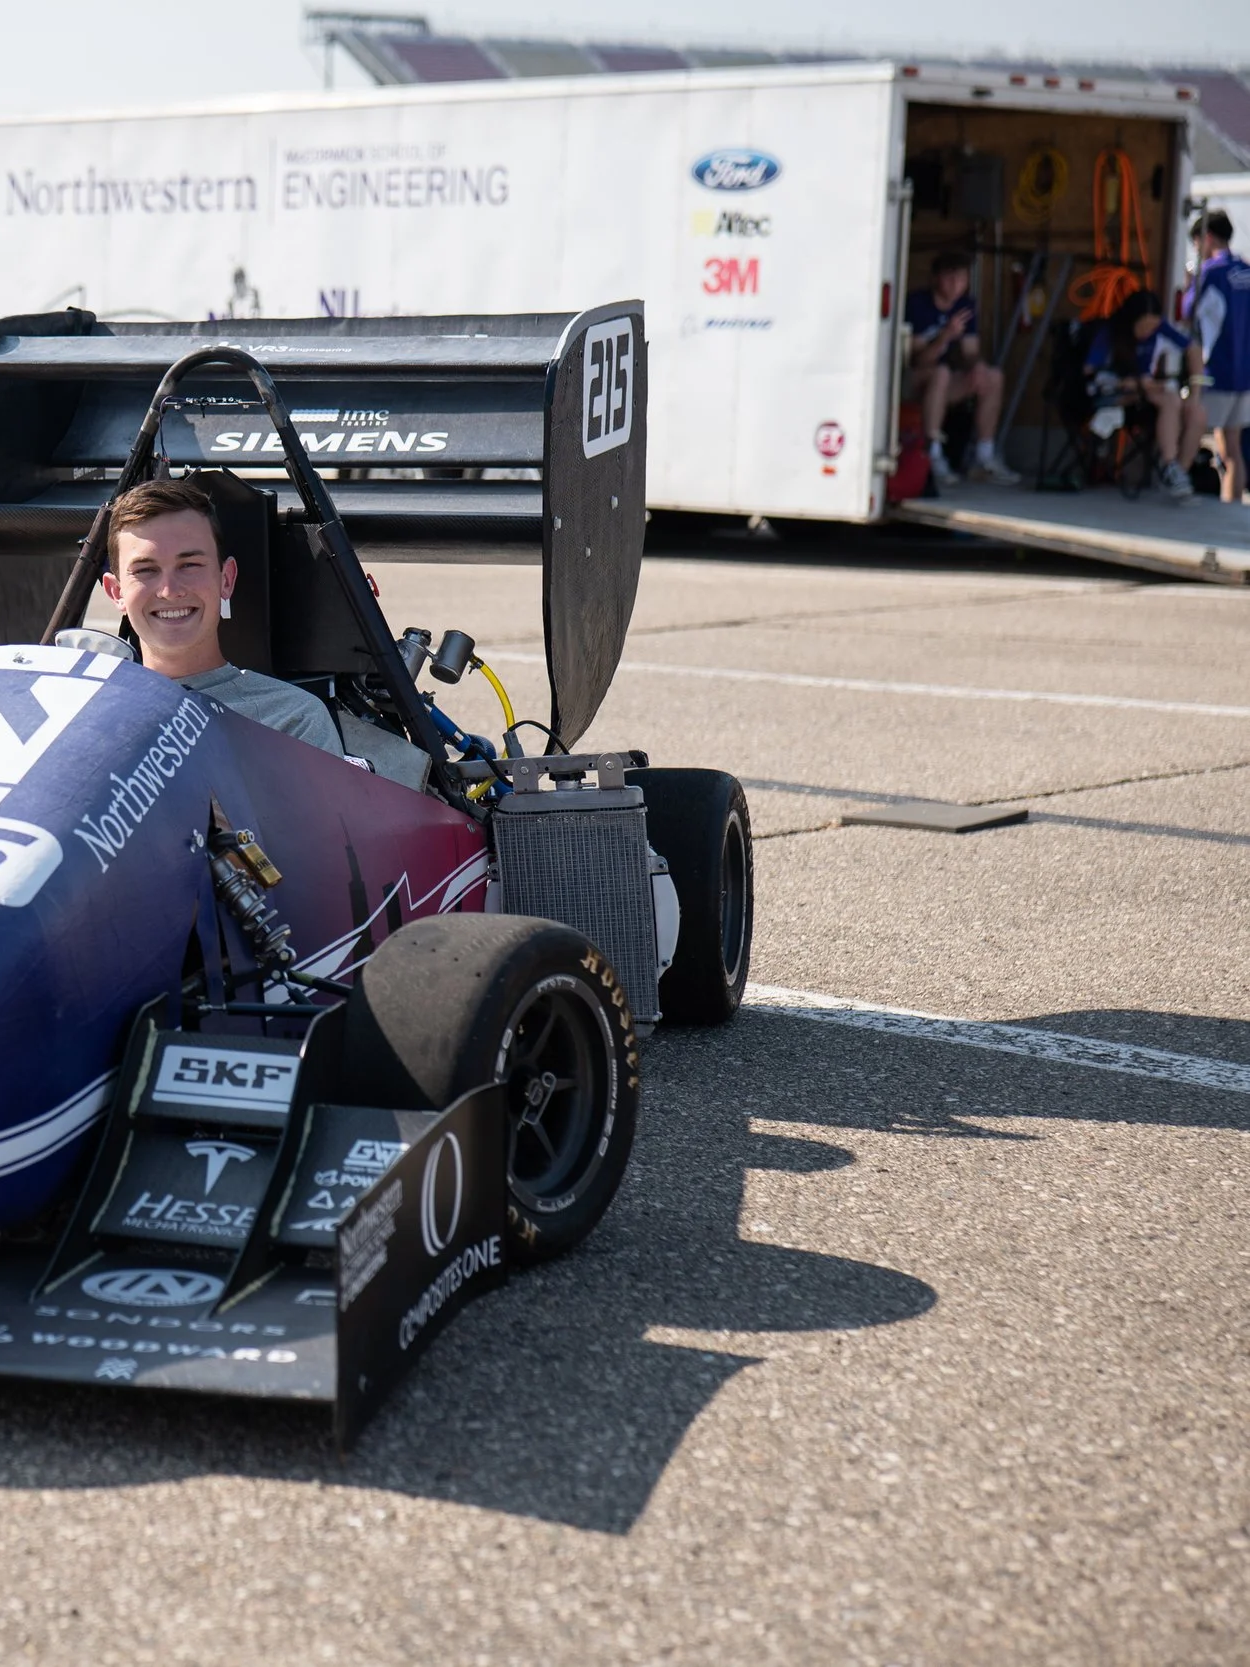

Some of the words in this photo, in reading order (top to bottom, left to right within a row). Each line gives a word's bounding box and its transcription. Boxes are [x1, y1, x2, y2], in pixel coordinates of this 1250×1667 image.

[283, 164, 509, 209] ENGINEERING
[705, 155, 768, 188] Ford
[7, 165, 258, 216] Northwestern
[702, 258, 761, 294] 3M
[587, 332, 630, 443] 215
[210, 431, 449, 452] SIEMENS
[73, 695, 210, 873] Northwestern
[173, 1057, 292, 1089] SKF
[127, 1191, 257, 1229] HESSE
[32, 1331, 298, 1364] WOODWARD
